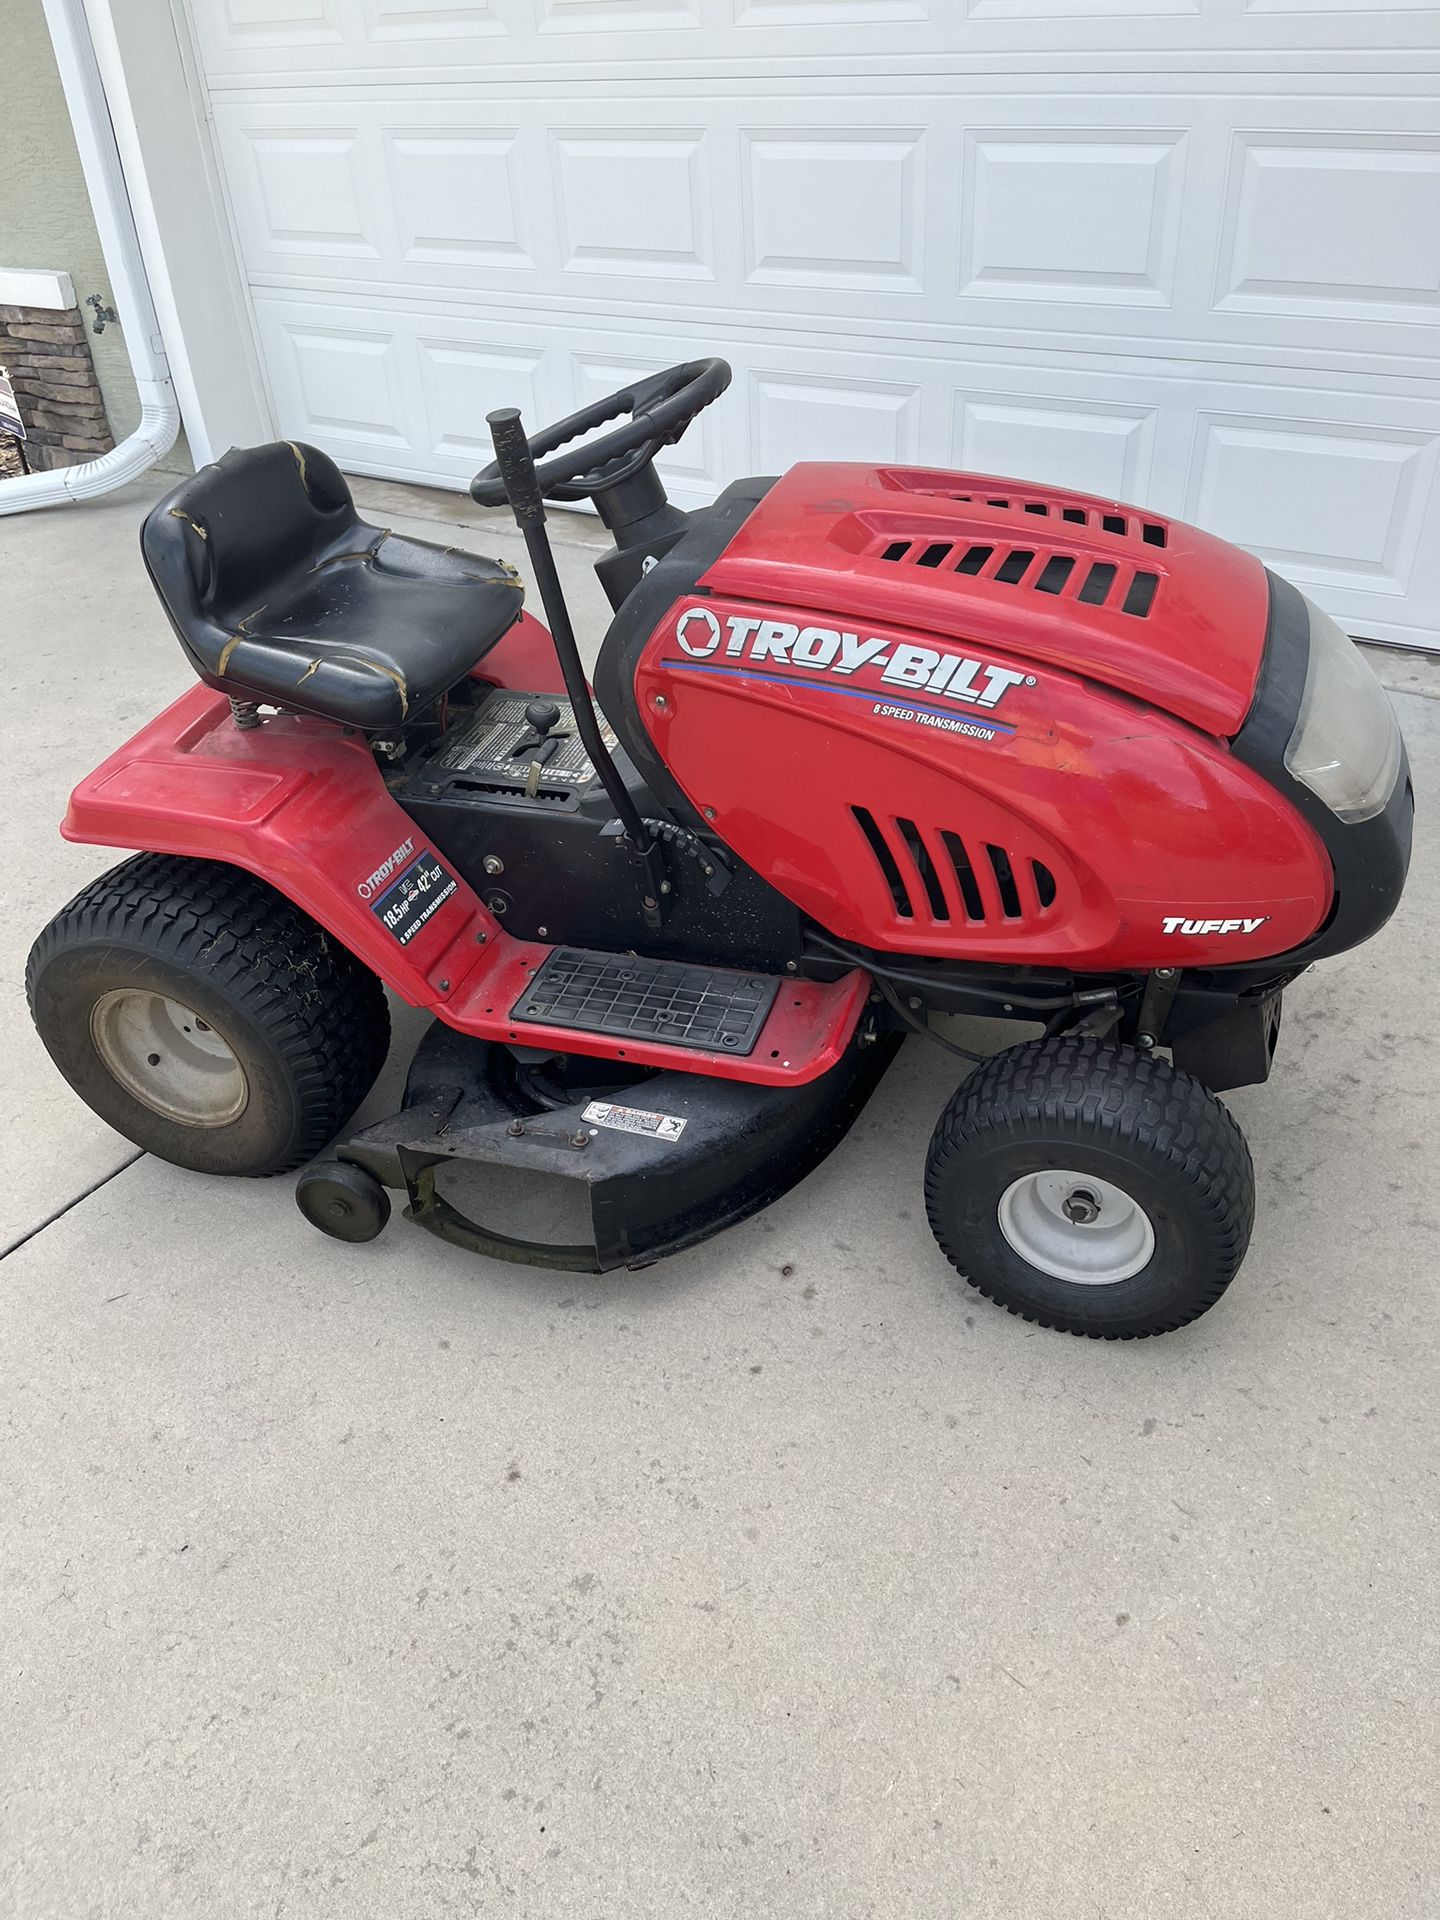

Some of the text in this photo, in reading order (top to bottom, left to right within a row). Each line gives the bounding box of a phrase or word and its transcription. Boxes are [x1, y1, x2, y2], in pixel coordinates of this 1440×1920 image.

[873, 704, 995, 740] 8 SPEED TRANSMISSION
[366, 837, 414, 890] TROY-BILT
[430, 865, 443, 882] CUT
[400, 936, 406, 944] 8
[404, 919, 421, 939] SPEED
[419, 880, 457, 922] TRANSMISSION
[1162, 917, 1265, 934] TUFFY
